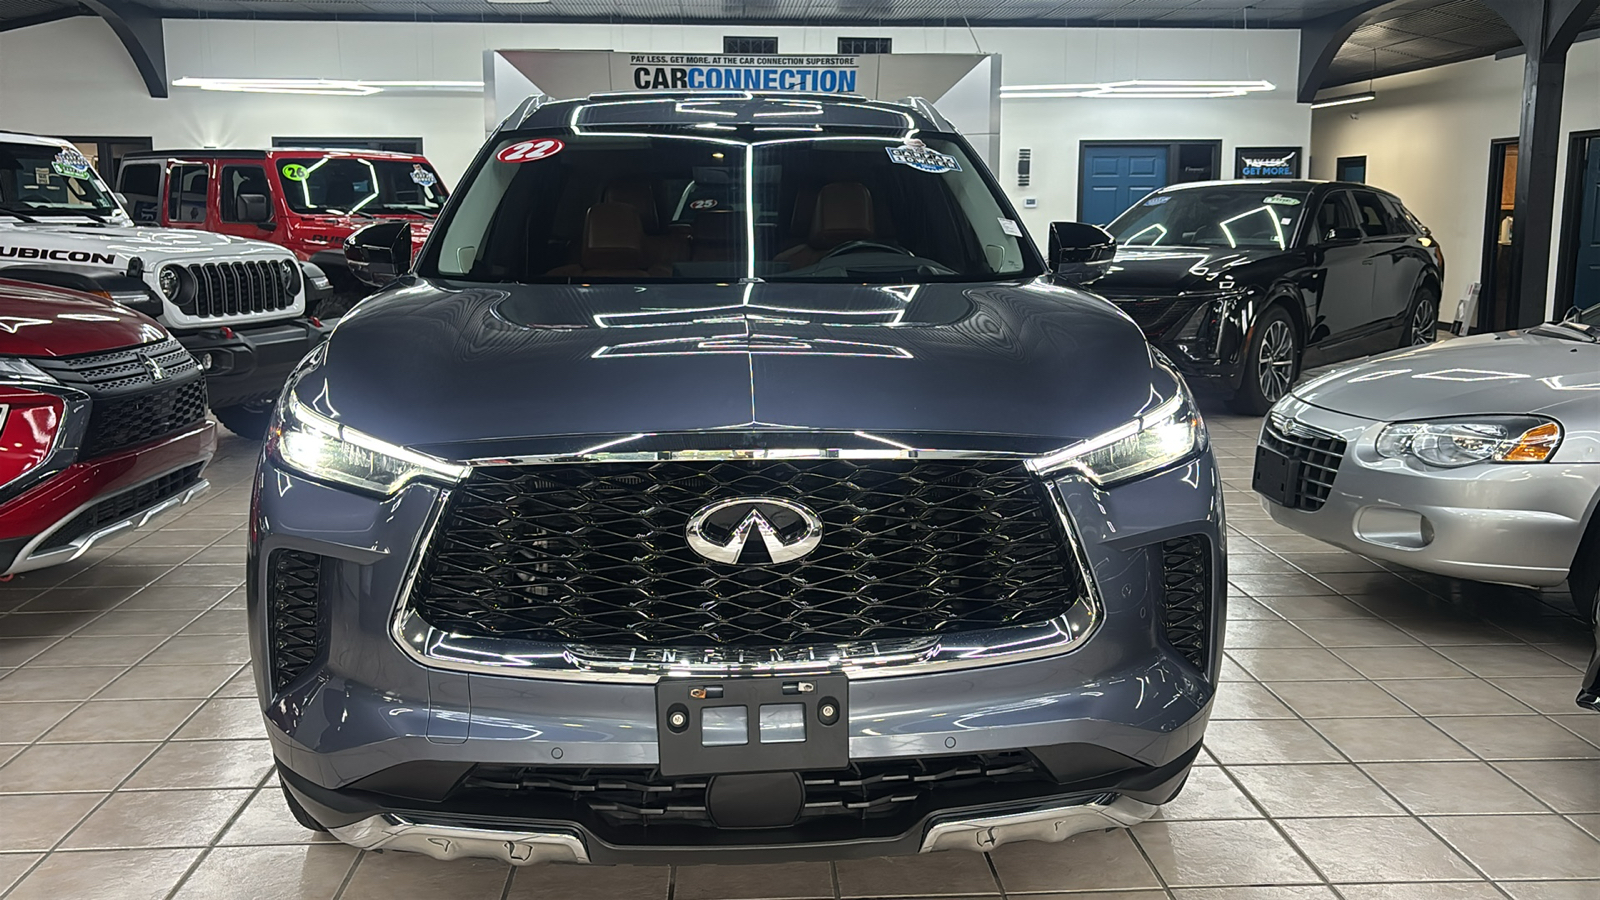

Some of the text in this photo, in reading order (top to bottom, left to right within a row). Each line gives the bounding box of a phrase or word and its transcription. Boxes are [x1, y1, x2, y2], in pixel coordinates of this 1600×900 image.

[631, 55, 645, 63] PAY
[647, 55, 668, 63] LESS.
[686, 56, 711, 64] MORE.
[756, 57, 804, 65] CONNECTION
[806, 57, 854, 65] SUPERSTORE
[504, 140, 555, 160] 22
[287, 167, 305, 178] 26
[1242, 167, 1293, 176] GET MORE.
[696, 200, 714, 209] 25
[0, 246, 116, 265] UBICON
